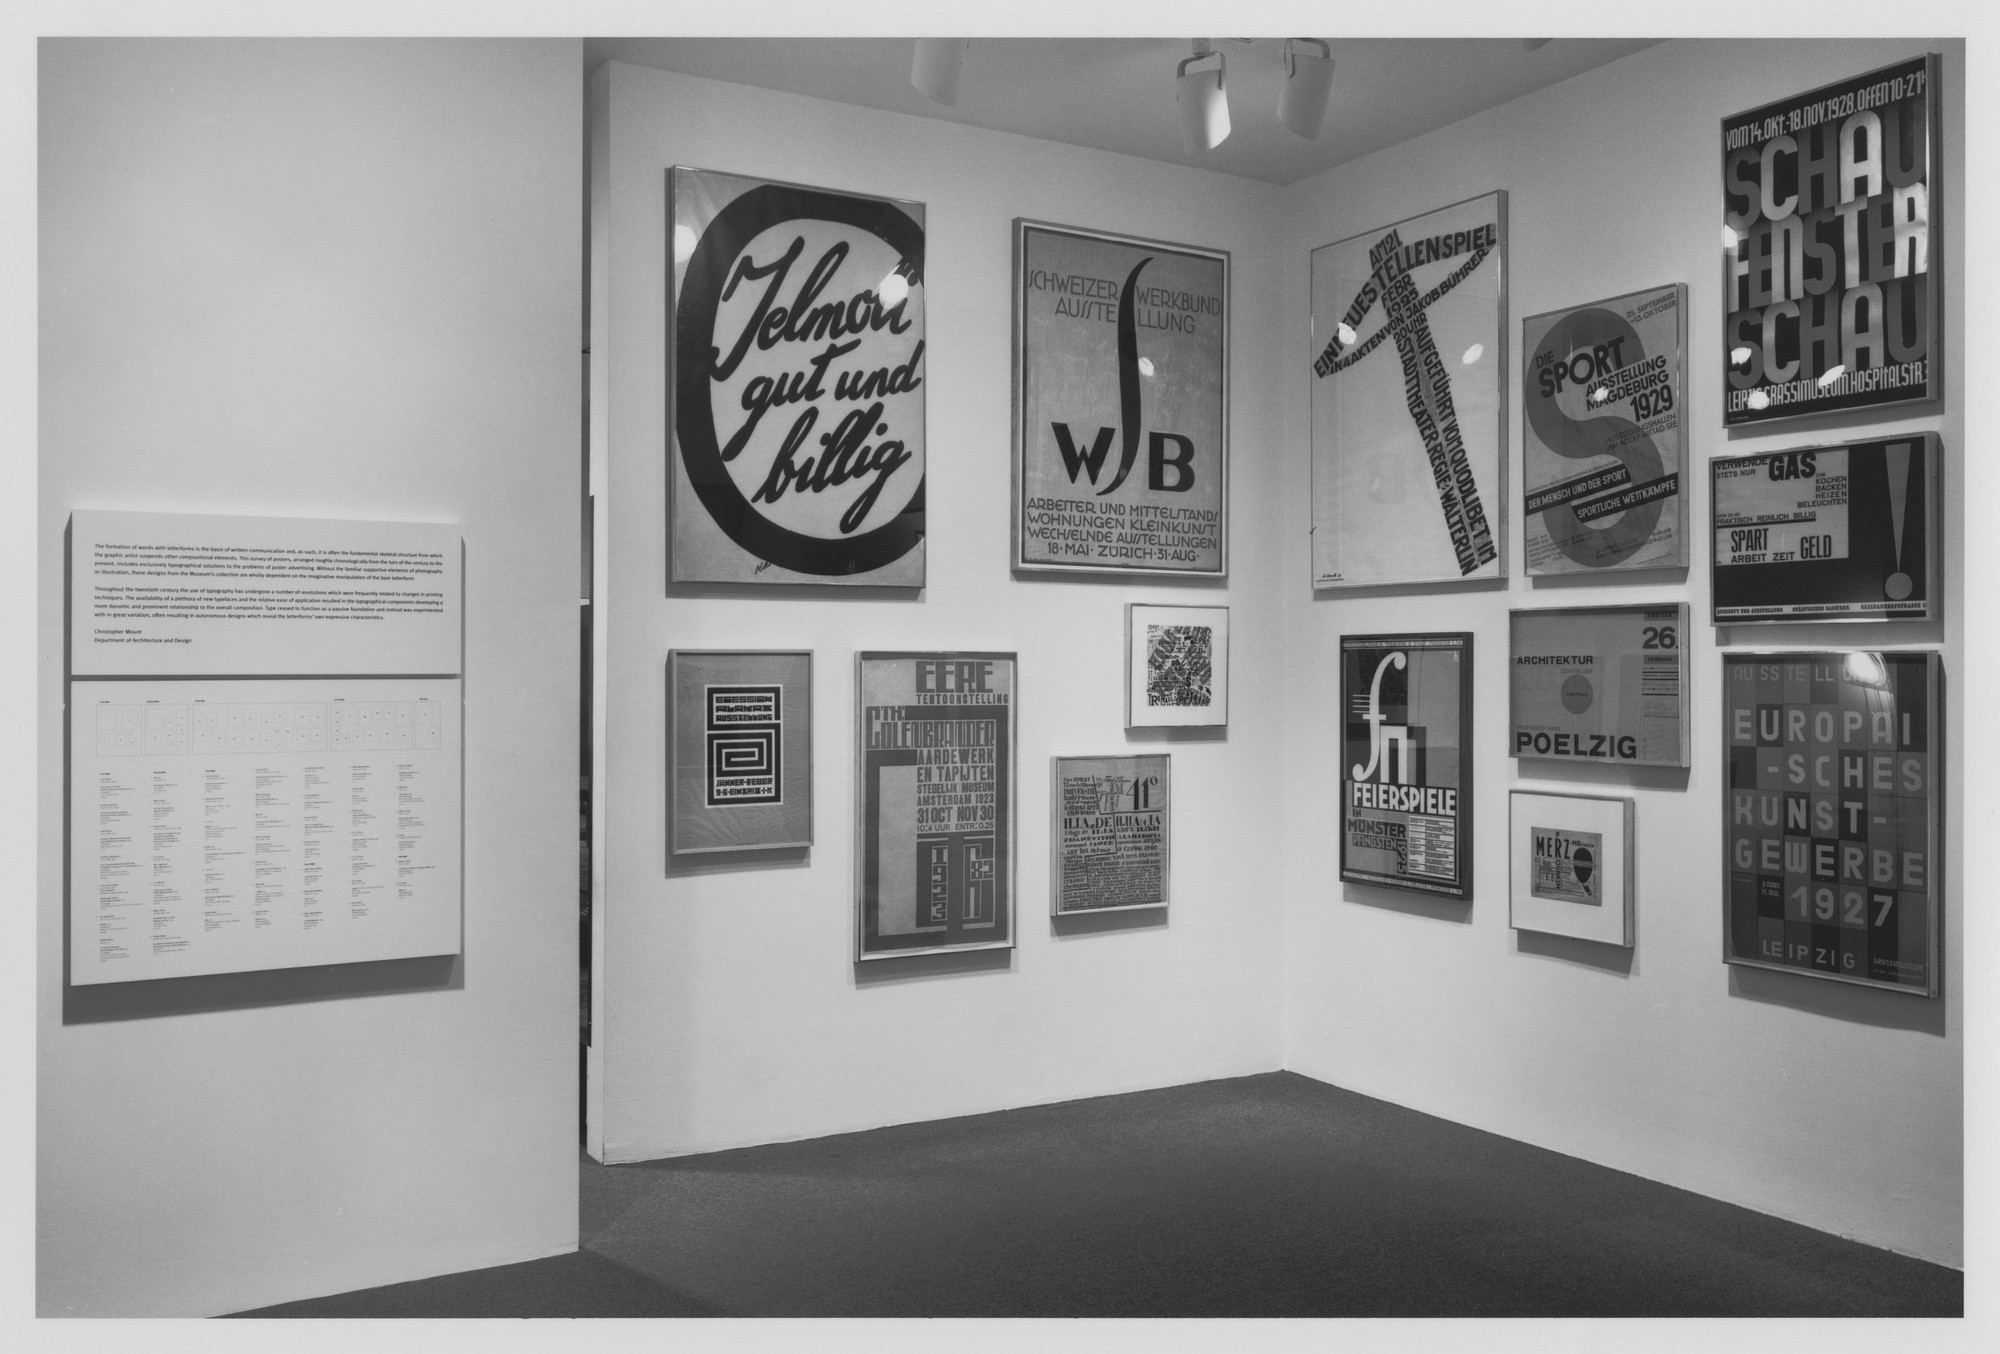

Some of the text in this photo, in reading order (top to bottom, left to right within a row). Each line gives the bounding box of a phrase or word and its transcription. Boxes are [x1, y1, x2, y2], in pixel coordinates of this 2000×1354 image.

[1727, 98, 1927, 229] SCHAU
[1371, 222, 1497, 290] TELLENSPIEL
[1028, 269, 1221, 316] SCHWEIZER WERKBUND
[1351, 330, 1386, 366] AKTEN
[1383, 313, 1405, 335] VON
[1405, 288, 1441, 319] JAKOB
[1440, 248, 1490, 297] BÜHRER
[1405, 312, 1428, 334] UHR
[1728, 279, 1927, 389] SCHAU
[1536, 351, 1555, 369] DIE
[1538, 336, 1625, 398] SPORT
[1586, 355, 1667, 397] AUSSTELLUNG
[721, 338, 925, 462] gut und
[1586, 370, 1669, 412] MAGDEBURG
[1629, 384, 1674, 422] 1929
[1728, 387, 1764, 412] LEIP
[1414, 324, 1497, 566] AUFGEFÜHRT VOM QUODLIBET IM
[750, 401, 913, 535] billig
[1716, 452, 1817, 481] VERWENDE GAS
[1716, 471, 1738, 479] STETS
[1528, 468, 1627, 510] DER MENSCH UND DER SPORT
[1816, 475, 1848, 485] KOCHEN
[1816, 483, 1848, 492] BACKEN
[1027, 497, 1097, 514] ARBEITER
[1099, 503, 1126, 516] UND
[1797, 498, 1848, 508] BELEUCHTEN
[1816, 491, 1848, 500] HEIZEN
[1577, 497, 1622, 519] SPORTLICHE
[1716, 511, 1817, 526] PRAKTISCH REINLICH BILLIG
[1027, 511, 1218, 536] WOHNUNGEN KLEINKUNST
[1027, 526, 1217, 550] WECHSELNDE AUSSTELLUNGEN
[1731, 528, 1832, 559] SPART GELD
[1731, 553, 1767, 564] ARBEIT
[1772, 551, 1795, 561] ZEIT
[112, 611, 126, 619] great
[166, 612, 188, 620] resulting
[226, 612, 246, 620] designs
[94, 628, 124, 636] Christopher
[174, 637, 192, 645] Design
[1517, 656, 1594, 665] ARCHITEKTUR
[915, 661, 994, 693] EERE
[916, 694, 1009, 705] TENTOONSTELLING
[917, 748, 994, 766] AARDEWERK
[1517, 732, 1637, 759] POELZIG
[917, 765, 995, 783] EN TAPIJTEN
[917, 780, 994, 795] STEDELIJK MUSEUM
[1353, 782, 1456, 816] FEIERSPIELE
[917, 793, 994, 807] AMSTERDAM 1923
[917, 805, 994, 824] 31 OCT NOV 30
[1353, 808, 1362, 817] IN
[1353, 834, 1398, 851] PFINGSTEN
[1536, 835, 1570, 860] MERZ
[1735, 838, 1924, 886] GEWERBE
[1790, 886, 1894, 927] 1927
[1763, 940, 1856, 969] LEIPZIG
